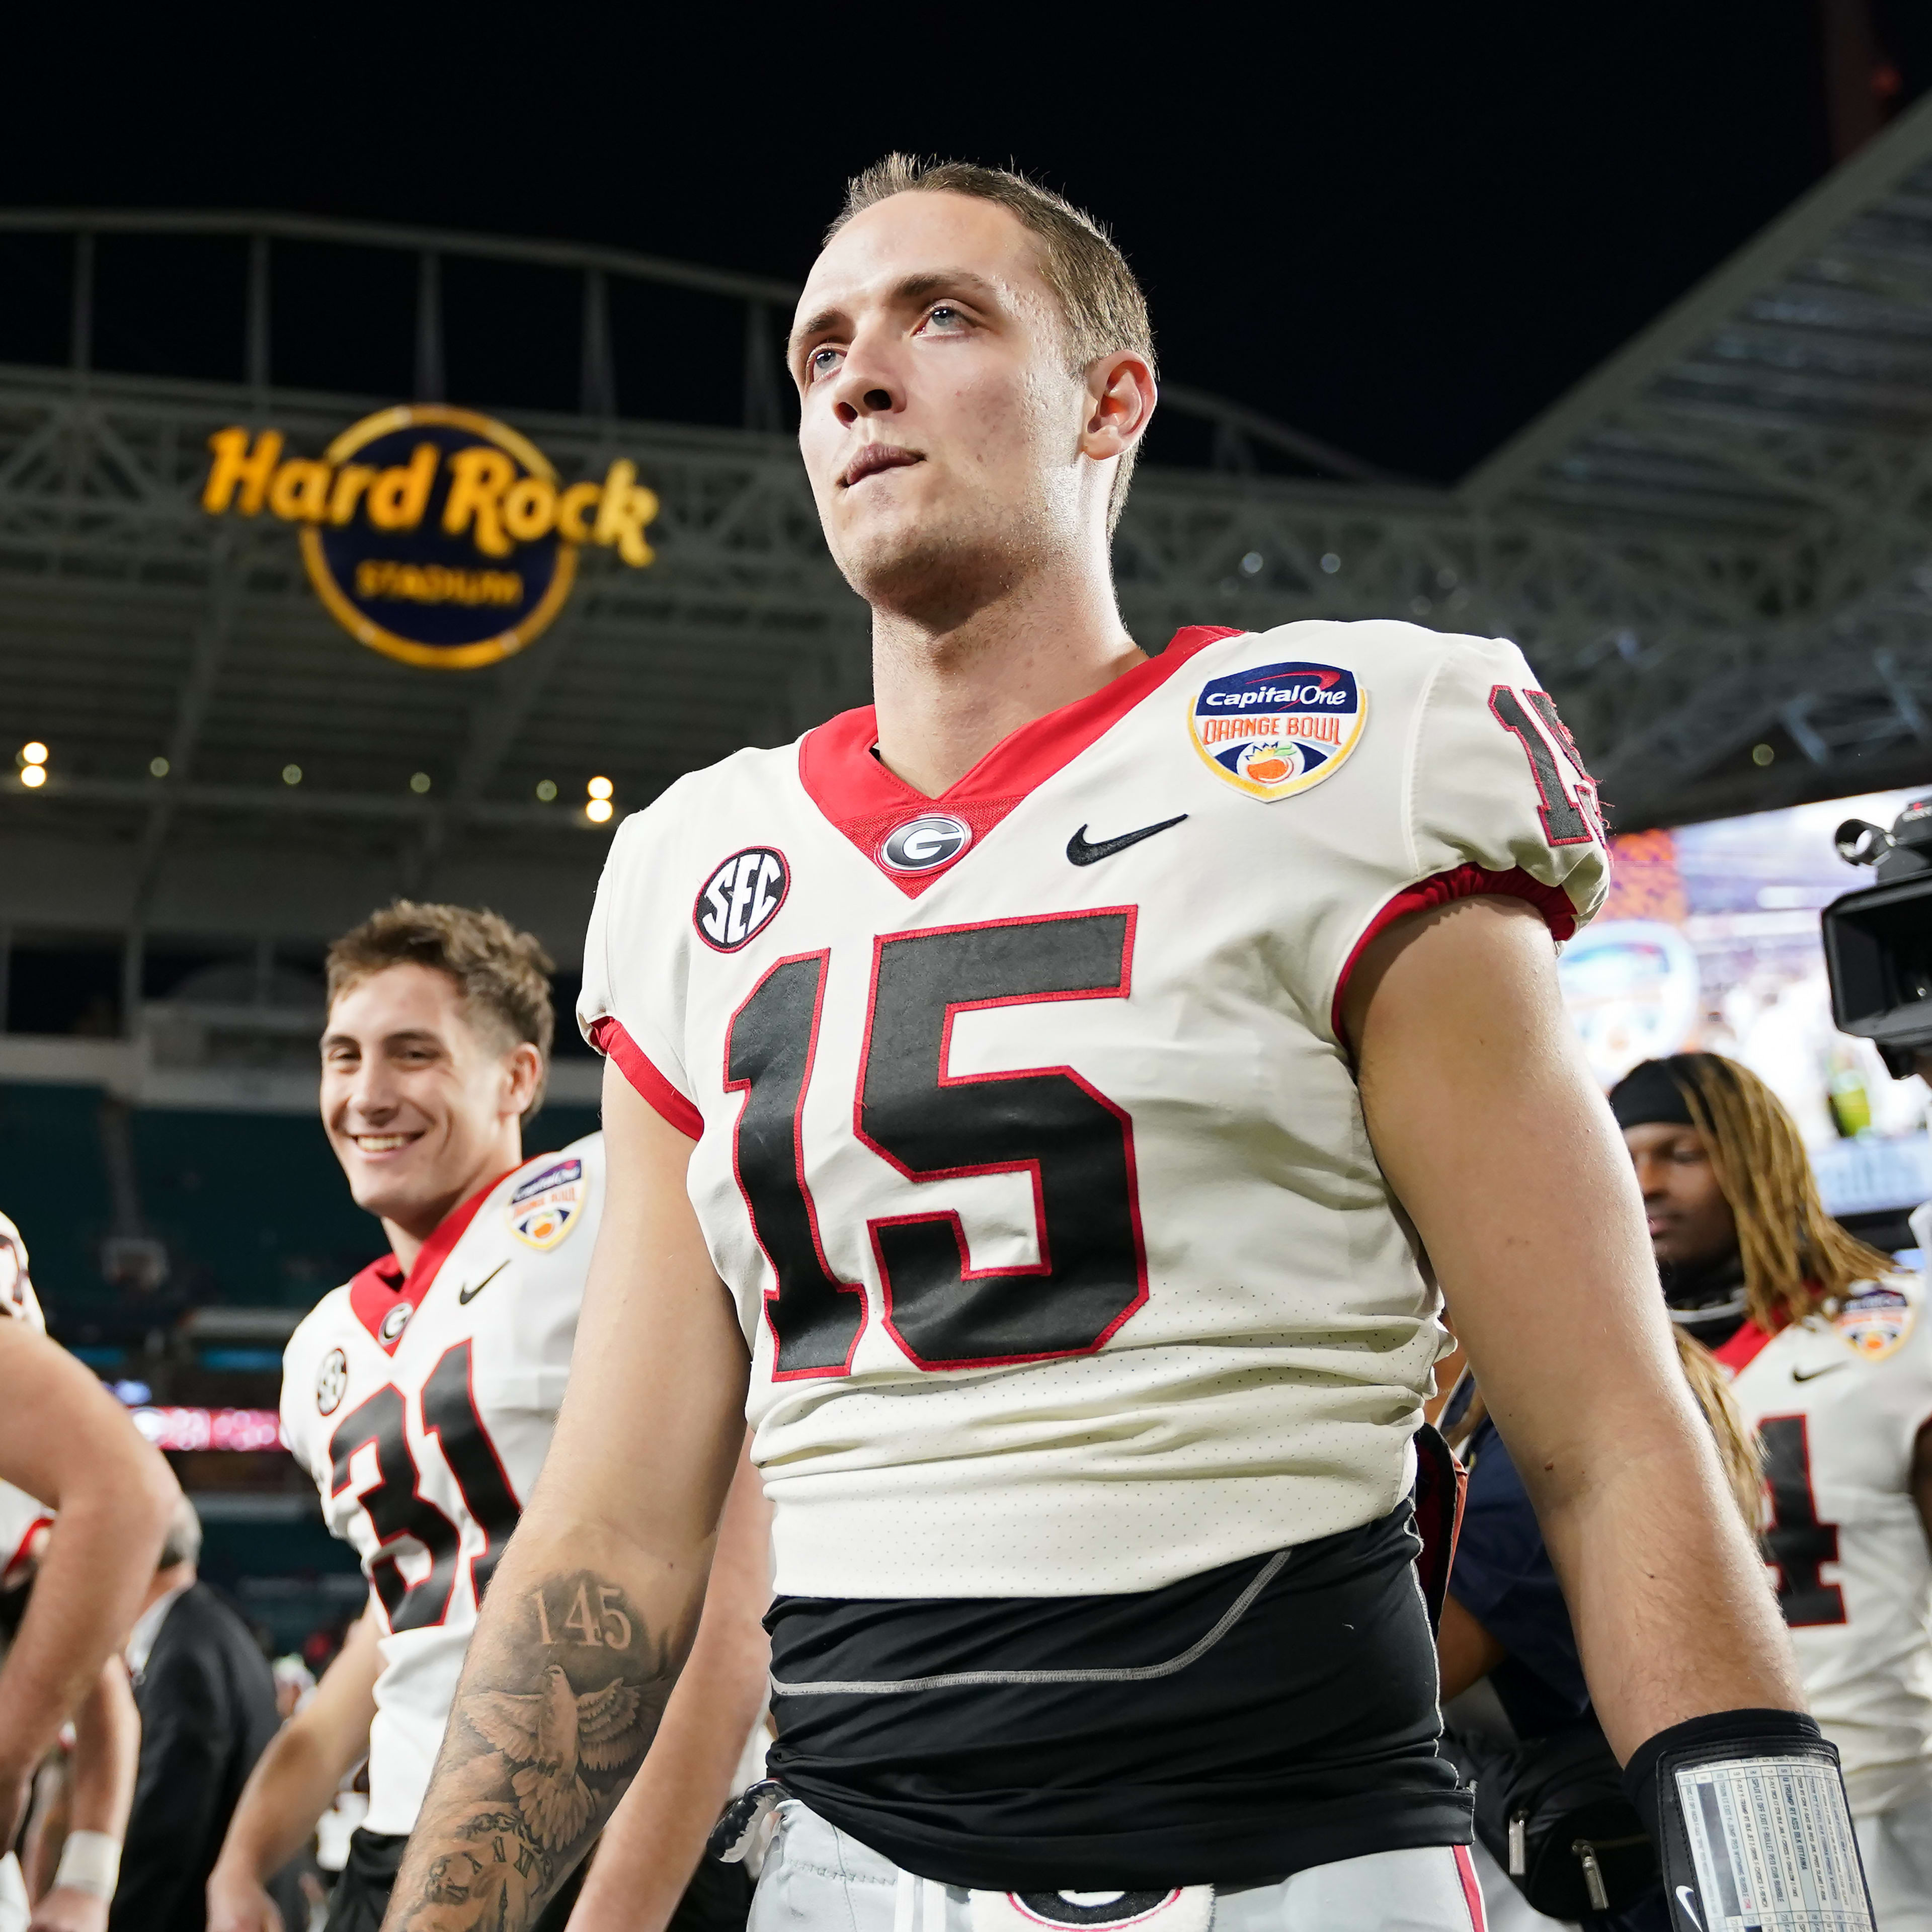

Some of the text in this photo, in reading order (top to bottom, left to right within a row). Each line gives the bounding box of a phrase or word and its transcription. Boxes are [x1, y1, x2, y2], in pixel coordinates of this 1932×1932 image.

[205, 425, 659, 568] Hard Rock
[355, 559, 524, 608] STADIUM
[1201, 716, 1342, 745] ORANGE BOWL
[702, 853, 781, 944] SEC
[723, 904, 1149, 1382] 15
[329, 1338, 523, 1634] 31
[532, 1583, 632, 1651] 145
